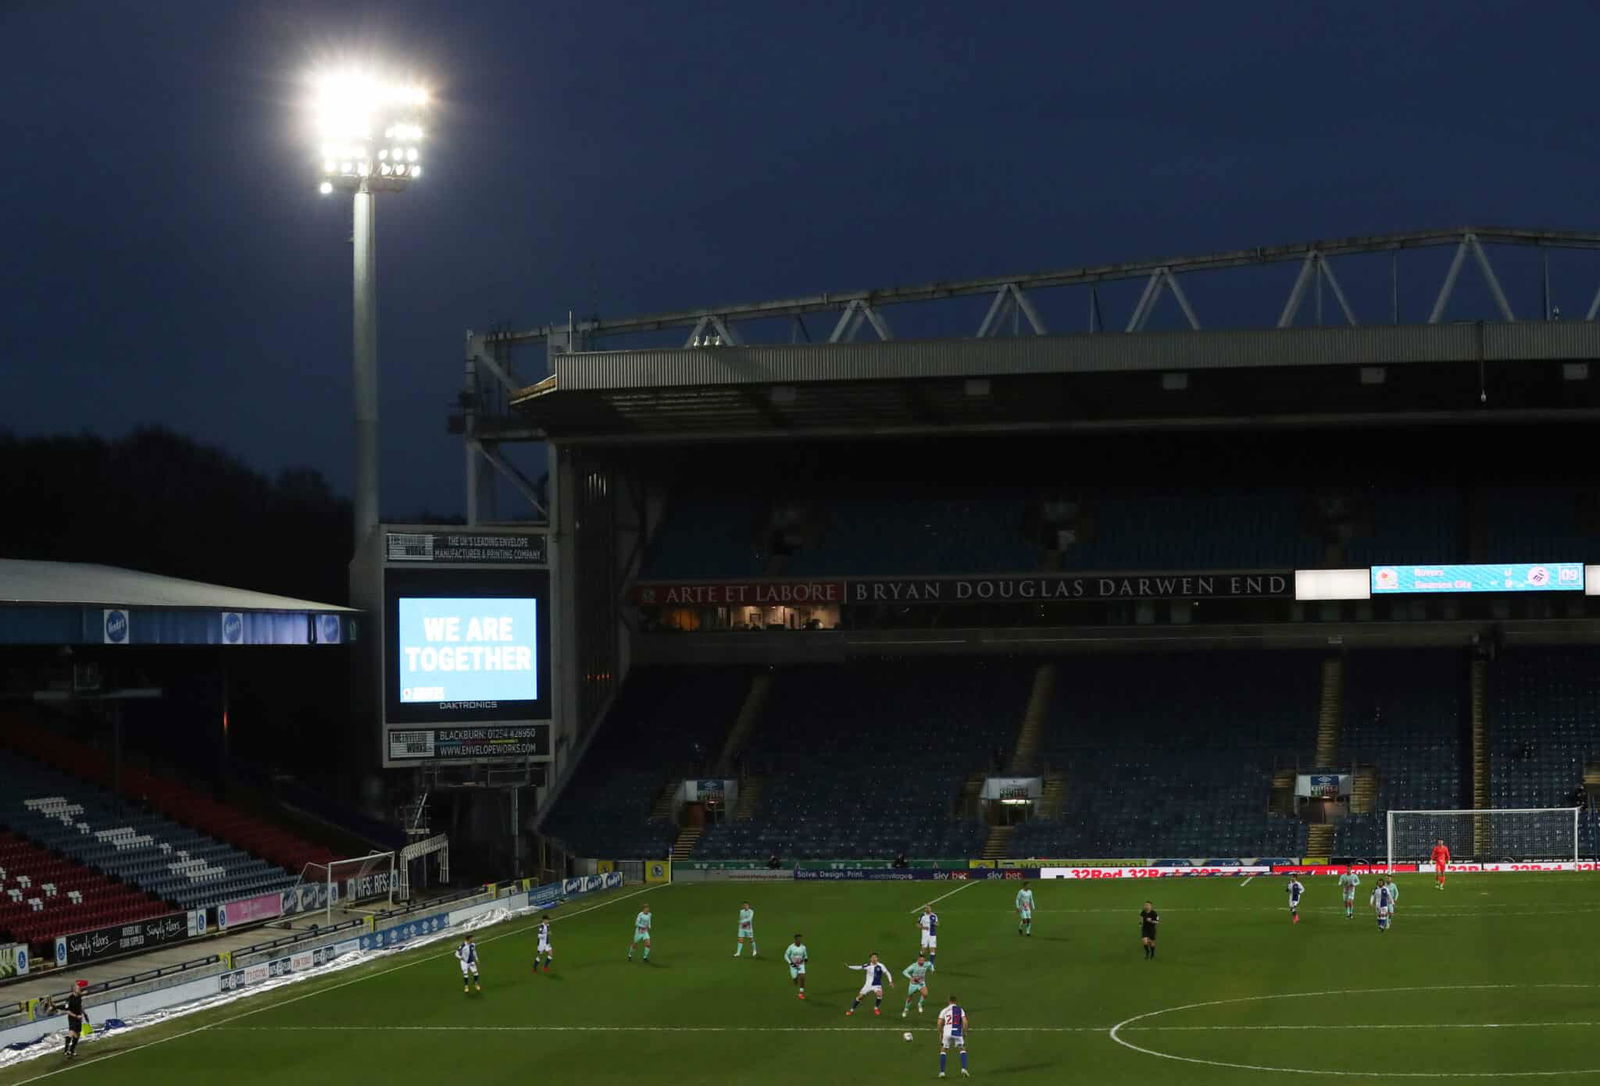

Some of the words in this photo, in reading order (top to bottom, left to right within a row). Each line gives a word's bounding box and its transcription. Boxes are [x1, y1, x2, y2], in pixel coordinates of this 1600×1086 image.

[666, 585, 716, 602] ARTE
[725, 585, 749, 601] ET
[756, 583, 836, 601] LABORE
[856, 583, 941, 600] BRYAN
[956, 579, 1085, 599] DOUGLAS
[1100, 576, 1215, 596] DARWEN
[1231, 576, 1286, 594] END
[424, 617, 460, 642] WE
[465, 617, 513, 641] ARE
[404, 647, 532, 671] TOGETHER
[440, 701, 498, 710] DAKTRONICS
[933, 871, 949, 880] sky
[987, 871, 1003, 880] sky
[1005, 871, 1022, 880] bet
[1071, 869, 1122, 879] 32Red
[146, 920, 166, 941] Simply
[69, 936, 92, 957] Simply
